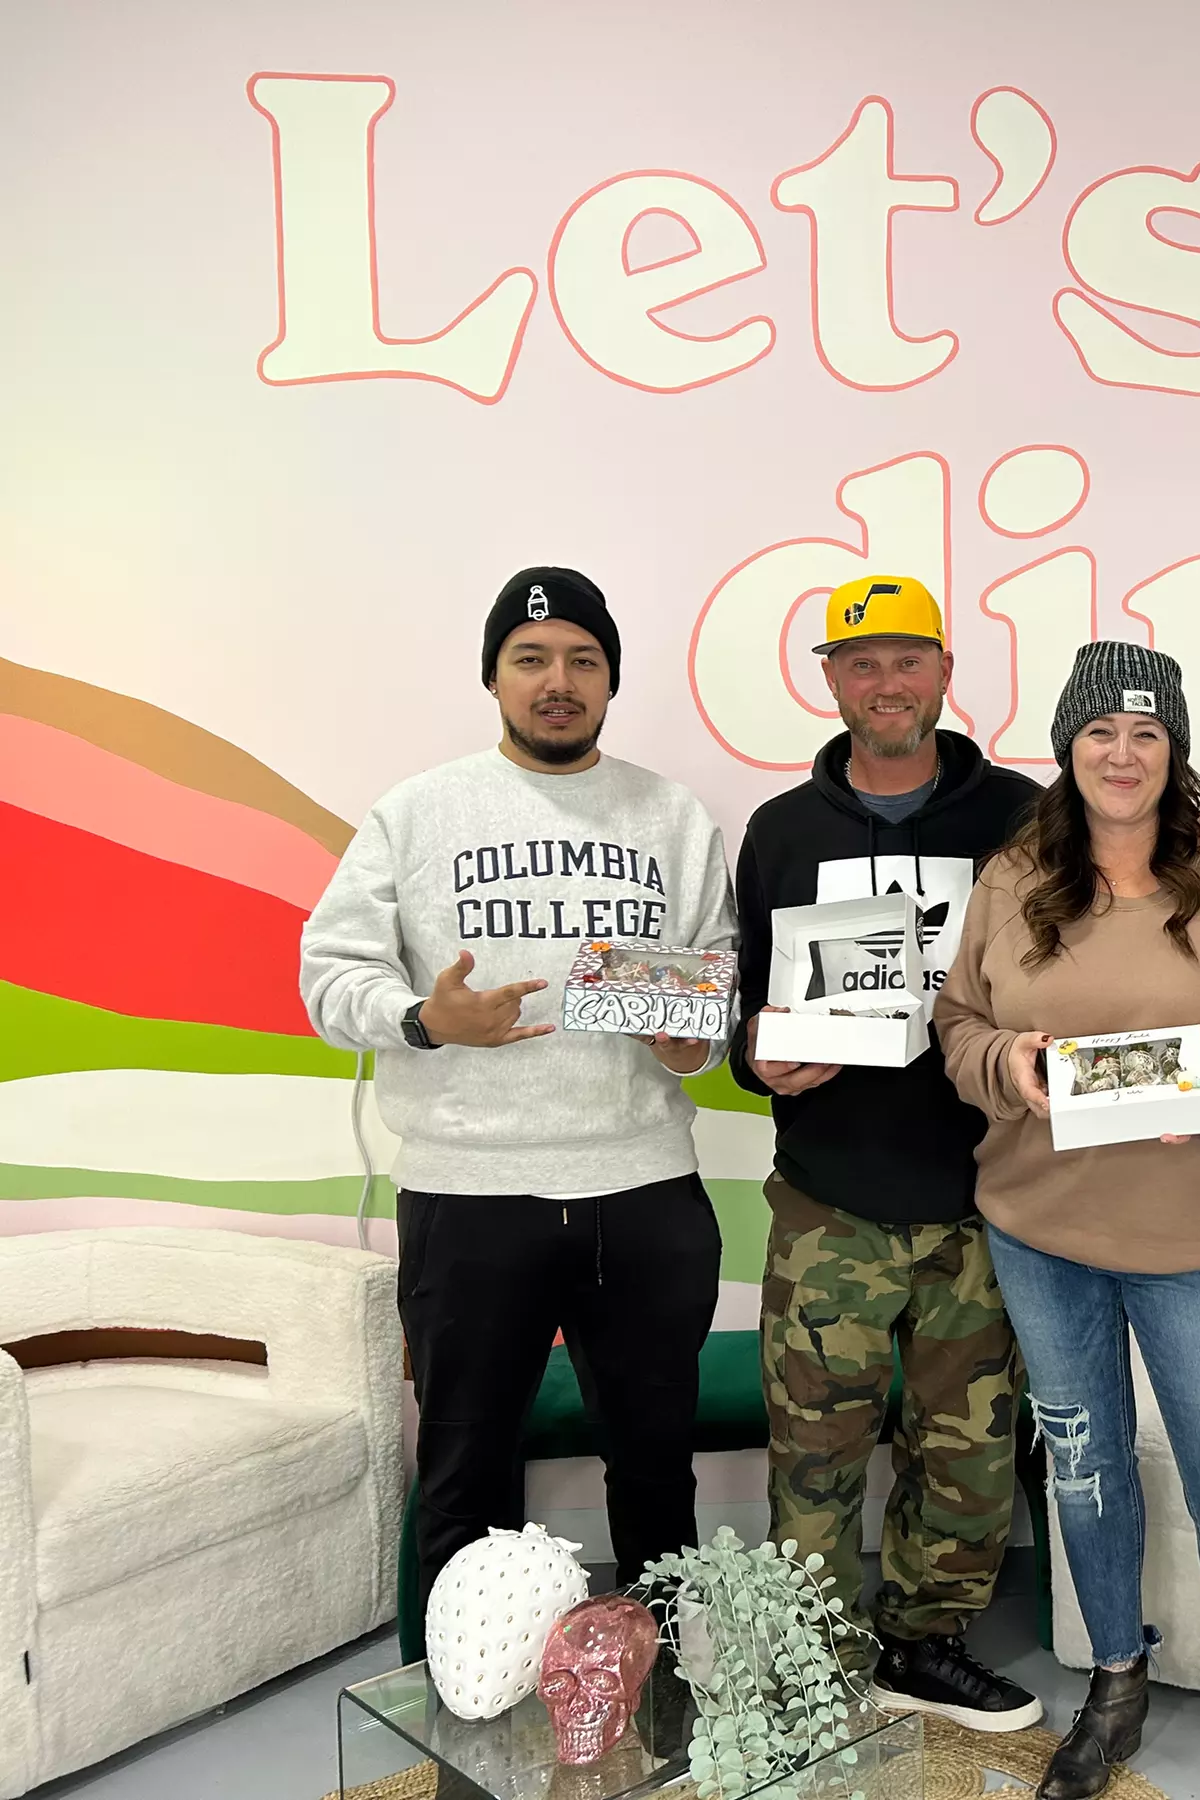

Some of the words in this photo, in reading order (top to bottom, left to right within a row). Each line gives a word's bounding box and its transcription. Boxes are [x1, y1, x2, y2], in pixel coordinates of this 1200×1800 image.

[453, 840, 666, 897] COLUMBIA
[456, 899, 666, 939] COLLEGE
[842, 964, 948, 992] adis
